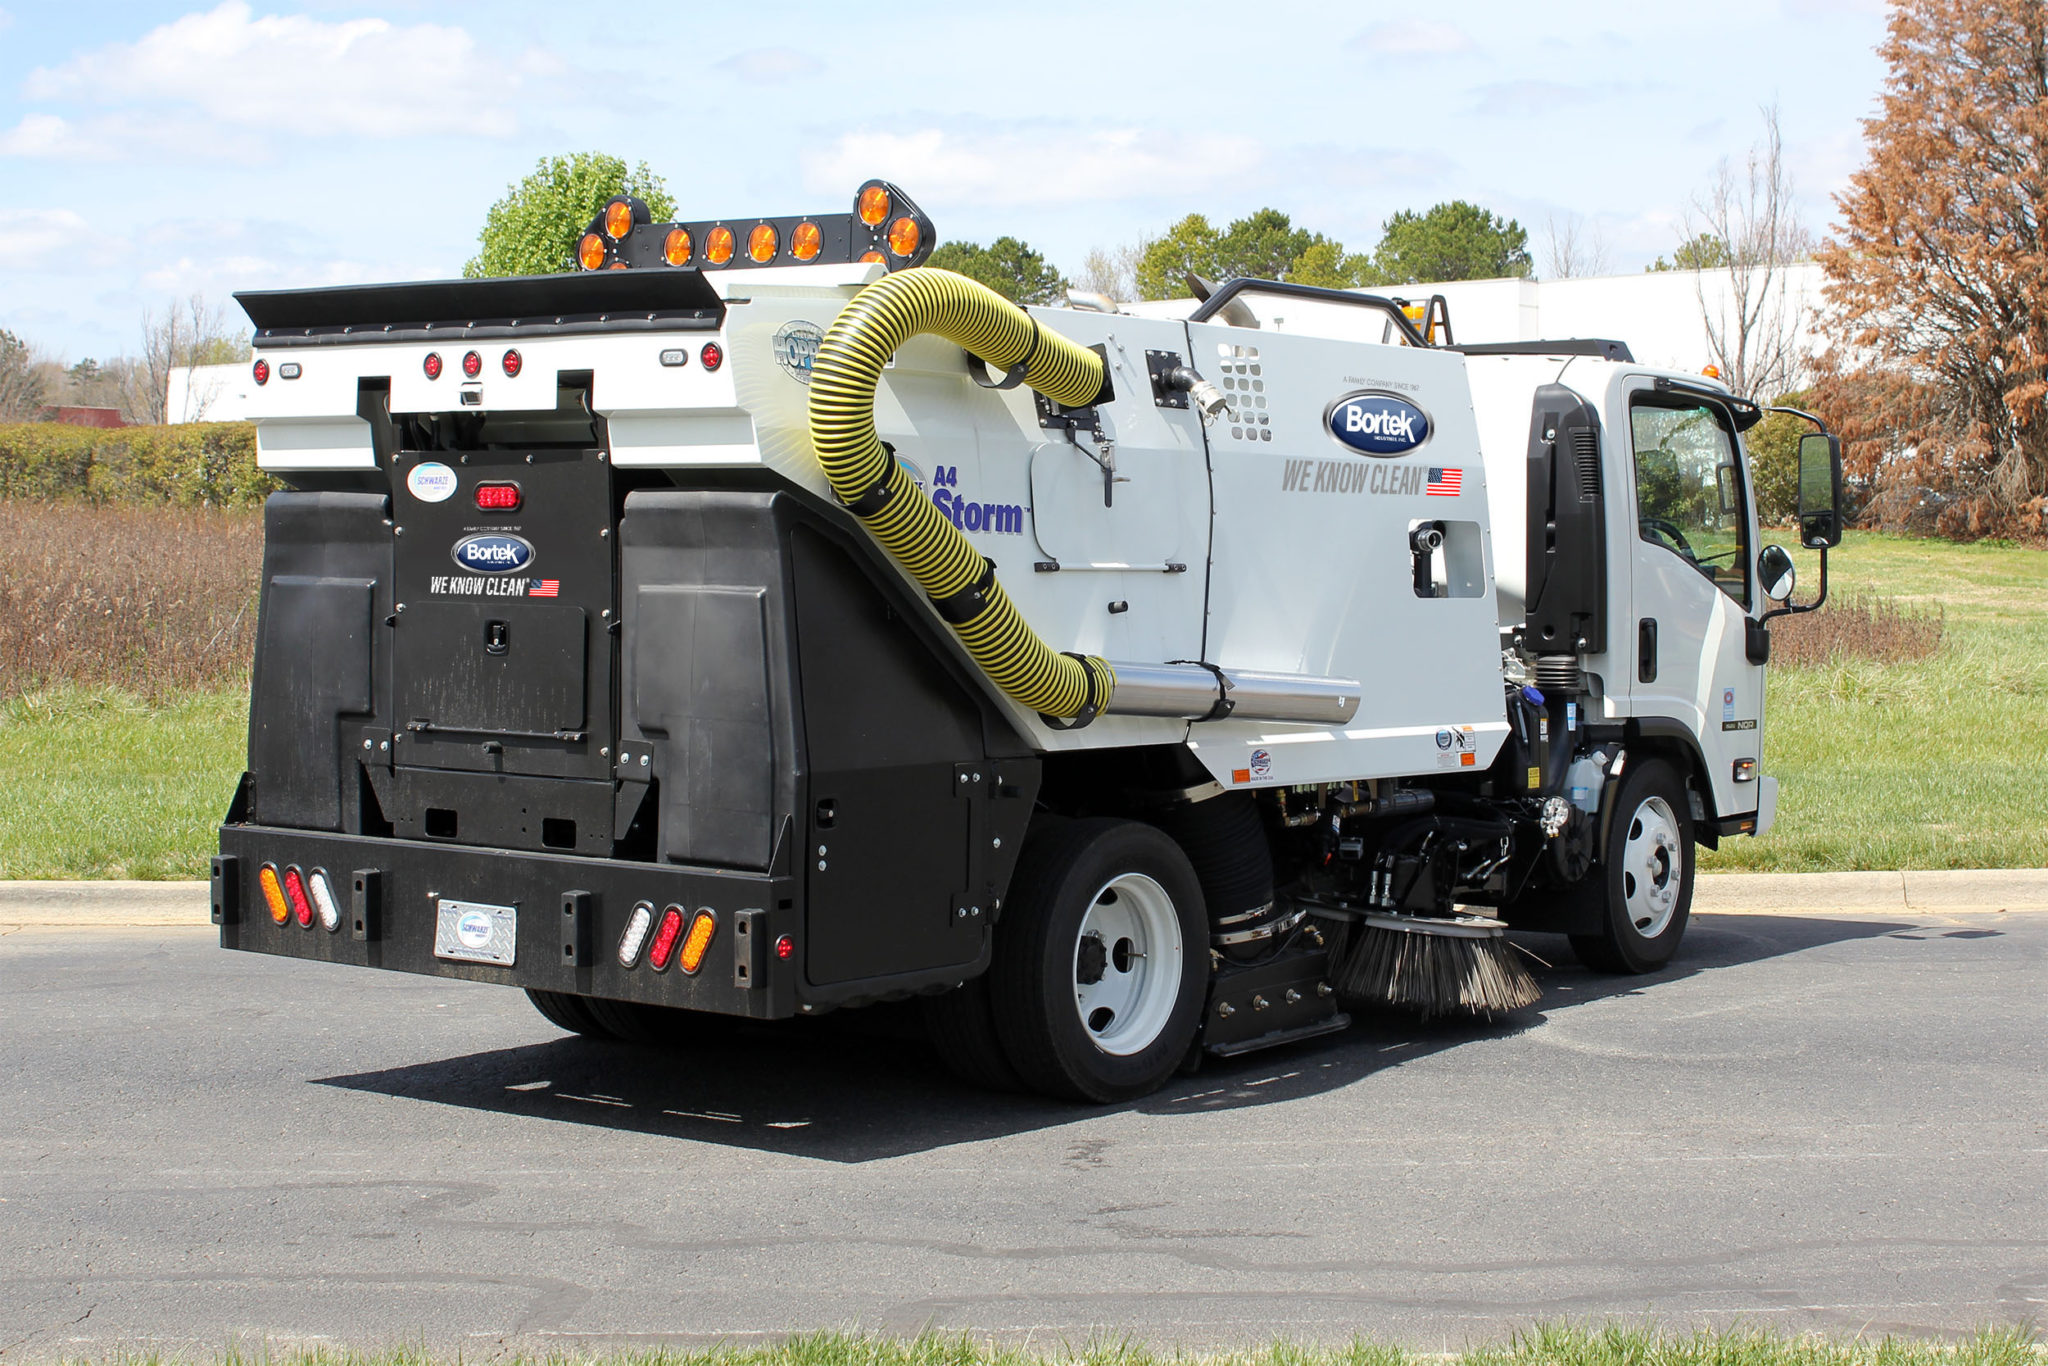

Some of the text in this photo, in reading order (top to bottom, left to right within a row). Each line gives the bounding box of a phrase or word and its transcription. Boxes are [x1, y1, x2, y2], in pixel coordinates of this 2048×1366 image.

[1366, 378, 1393, 389] COMPANY
[1346, 405, 1416, 443] Bortek
[933, 465, 957, 487] A4
[1282, 459, 1313, 492] WE
[1313, 461, 1369, 494] KNOW
[467, 543, 519, 564] Bortek
[430, 576, 448, 594] WE
[449, 576, 485, 595] KNOW
